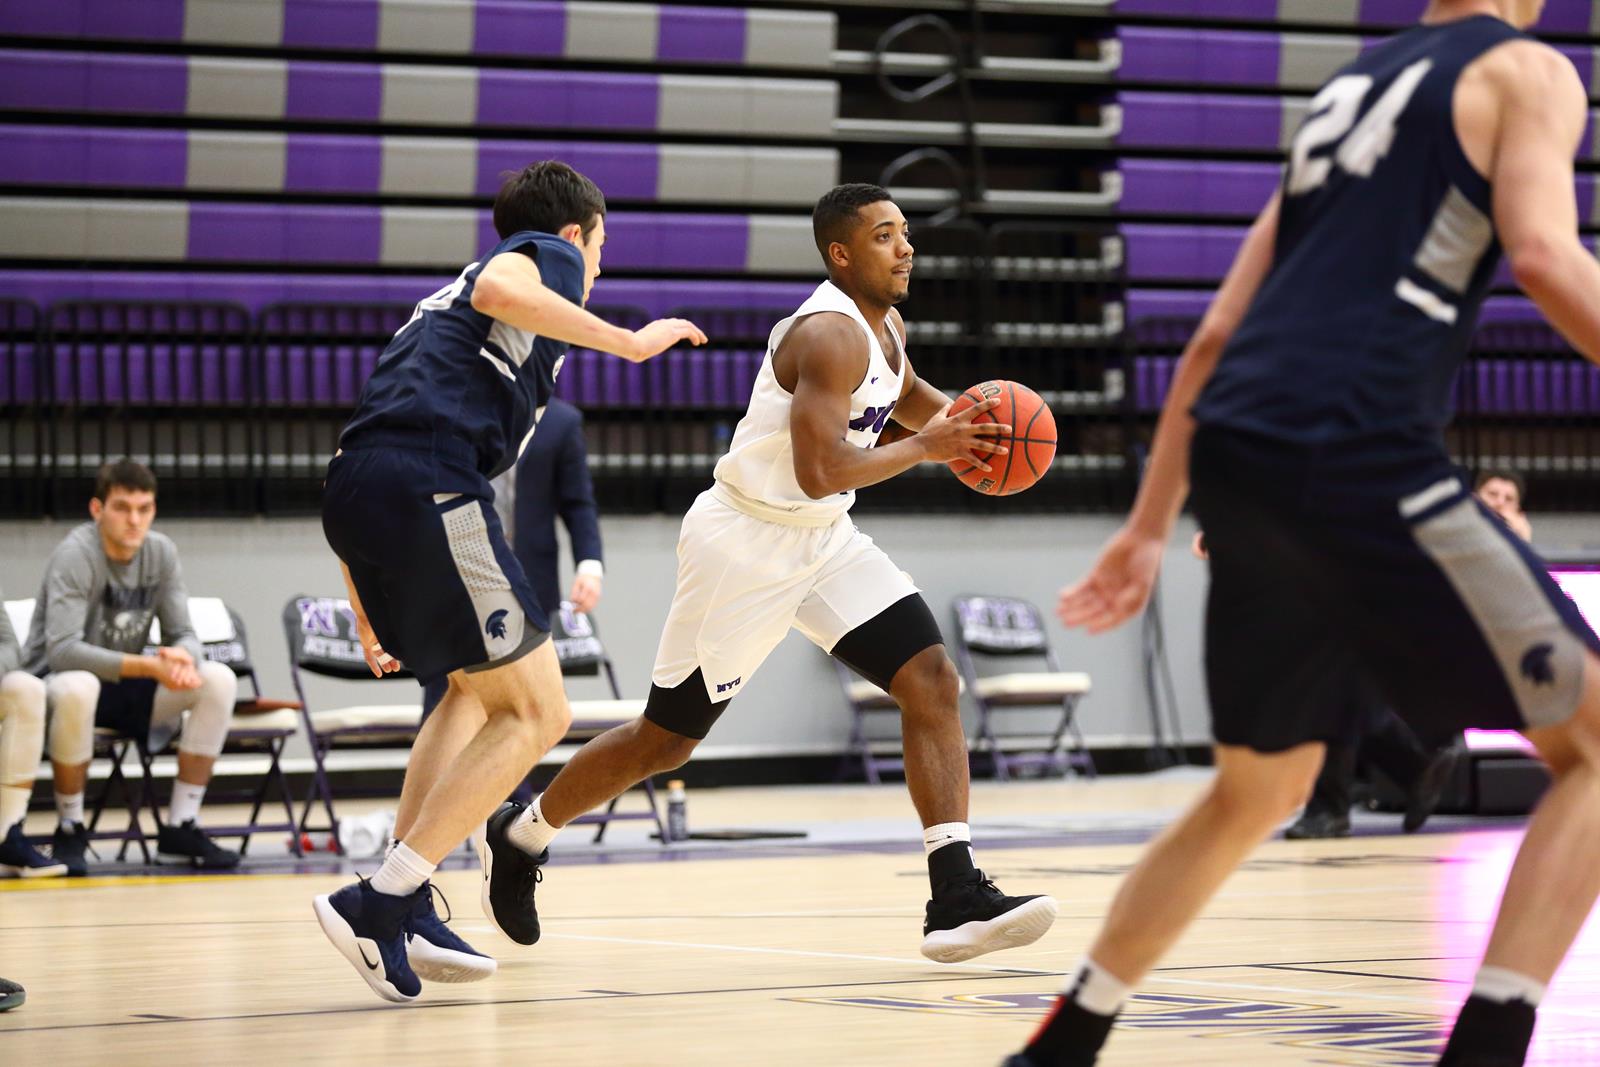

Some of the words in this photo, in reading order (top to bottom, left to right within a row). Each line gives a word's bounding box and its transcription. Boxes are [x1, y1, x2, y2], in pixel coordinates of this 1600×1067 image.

[1287, 57, 1433, 195] 24
[297, 597, 359, 640] NY
[716, 676, 741, 693] NYU
